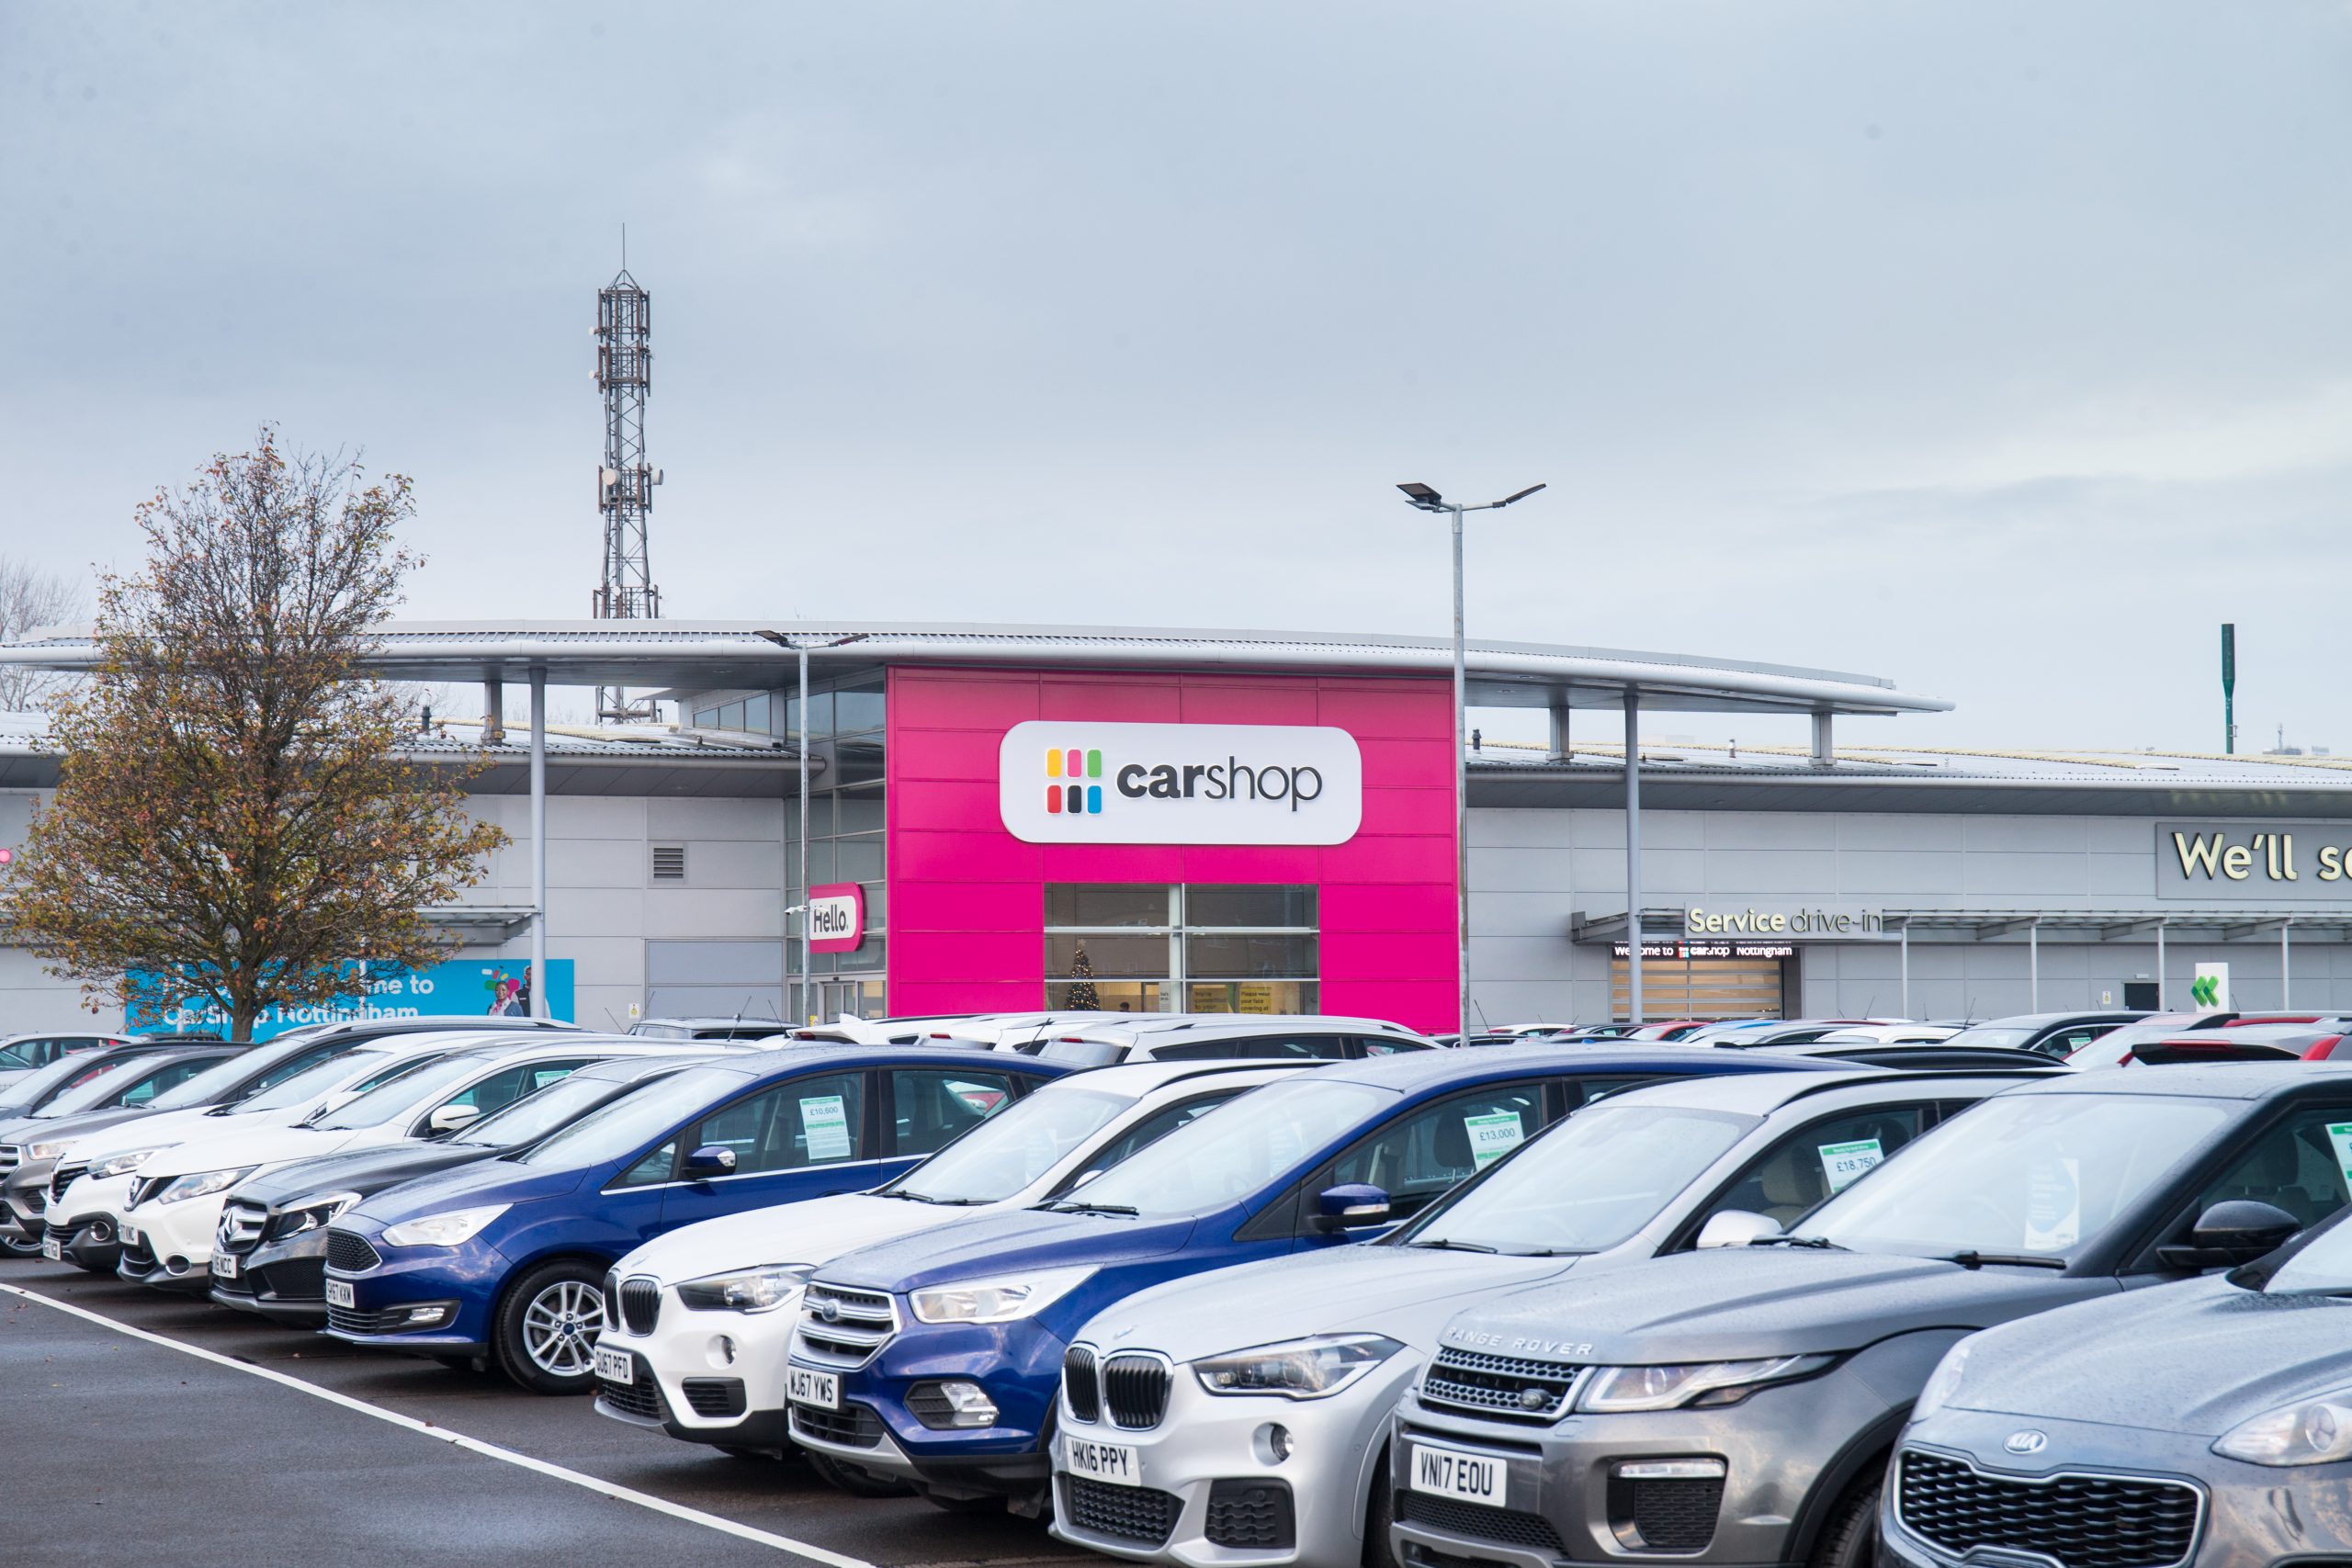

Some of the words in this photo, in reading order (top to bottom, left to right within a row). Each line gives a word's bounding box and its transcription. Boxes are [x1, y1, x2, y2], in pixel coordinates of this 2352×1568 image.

[1116, 756, 1323, 812] carshop
[2171, 832, 2298, 881] We'll
[2317, 845, 2352, 881] s
[1689, 908, 1787, 933] Service
[1791, 908, 1883, 932] drive-in
[1615, 946, 1660, 956] Weome
[1662, 946, 1674, 956] to
[409, 975, 435, 995] to
[1479, 1127, 1515, 1141] £13,000
[1837, 1156, 1877, 1171] £18,750
[1447, 1326, 1503, 1348] RANGE
[1511, 1337, 1594, 1357] ROVER
[613, 1355, 628, 1380] PFD
[791, 1370, 811, 1398] WJ67
[814, 1375, 833, 1403] YWS
[1071, 1439, 1099, 1472] HK16
[1100, 1445, 1127, 1477] PPY
[1420, 1451, 1453, 1490] VN17
[1457, 1459, 1493, 1496] EOU
